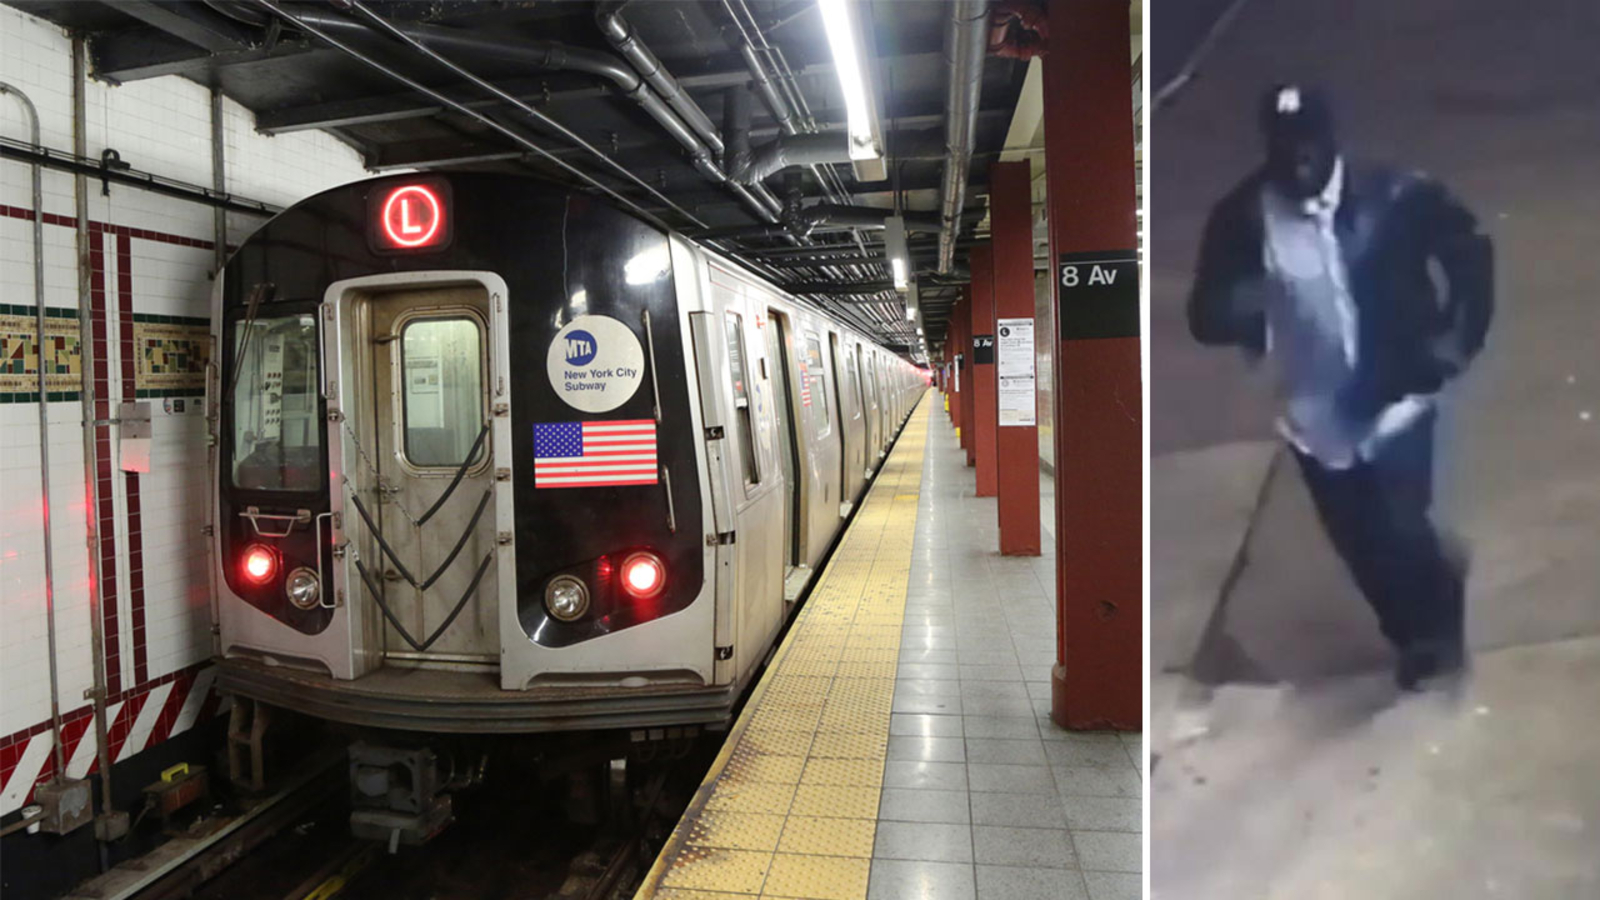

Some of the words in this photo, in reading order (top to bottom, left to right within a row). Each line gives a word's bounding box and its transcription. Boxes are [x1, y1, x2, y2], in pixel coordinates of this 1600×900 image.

[401, 199, 421, 233] L
[1062, 265, 1079, 287] 8
[1087, 264, 1118, 286] Av
[564, 338, 591, 359] MTA
[982, 338, 993, 347] Av
[564, 371, 585, 379] New
[590, 369, 613, 377] York
[616, 368, 636, 378] City
[565, 382, 606, 391] Subway
